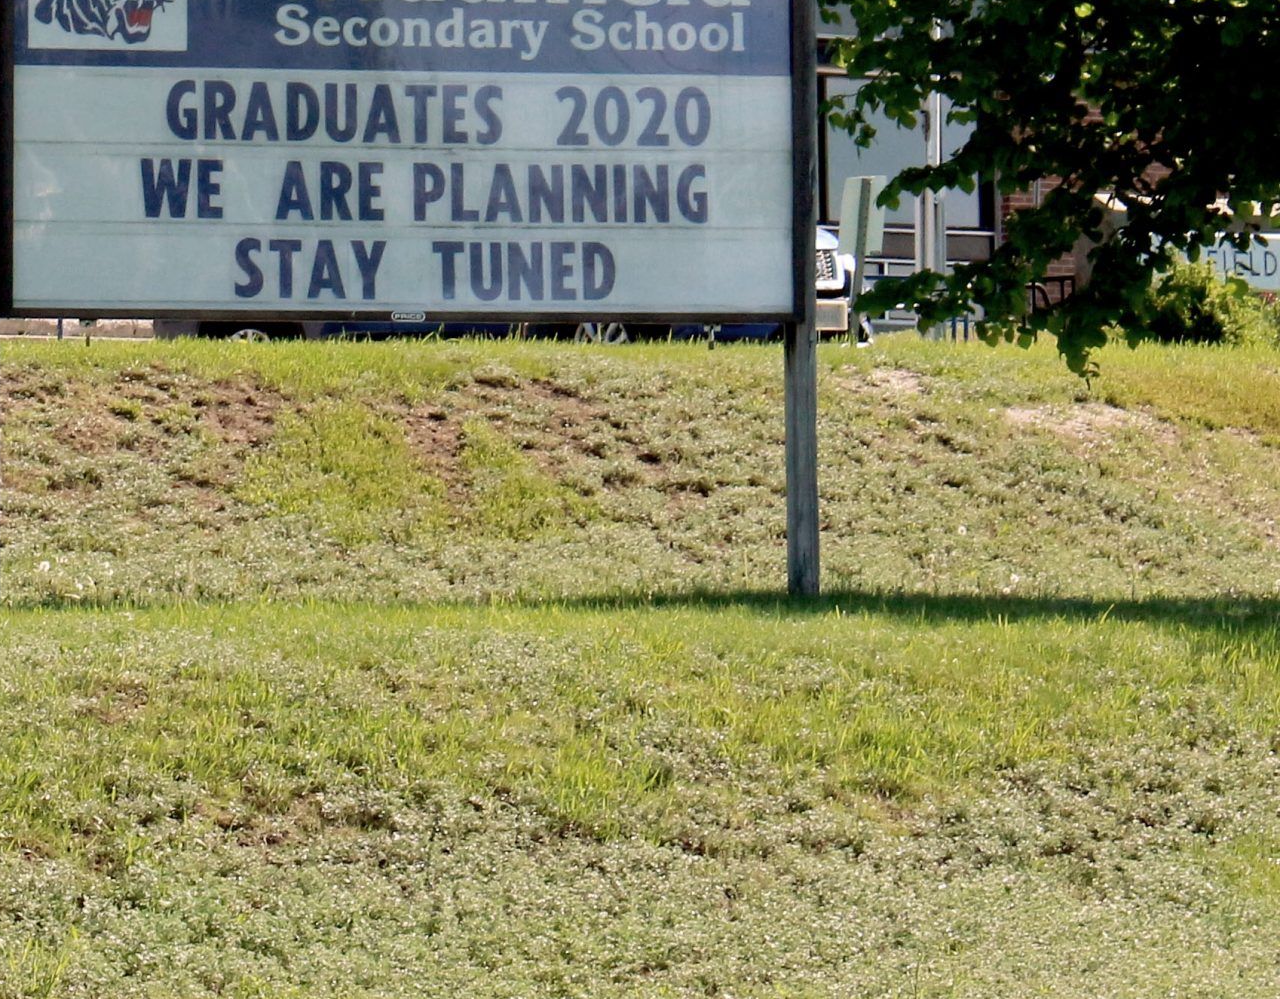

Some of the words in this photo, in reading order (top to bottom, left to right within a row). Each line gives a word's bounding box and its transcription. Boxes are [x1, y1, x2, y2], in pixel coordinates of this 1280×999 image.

[274, 3, 549, 60] Secondary
[570, 9, 745, 52] School
[166, 79, 503, 145] GRADUATES
[556, 86, 711, 147] 2020
[140, 157, 224, 219] WE
[276, 161, 385, 222] ARE
[413, 163, 708, 224] PLANNING
[234, 237, 387, 300] STAY
[432, 241, 616, 301] TUNED
